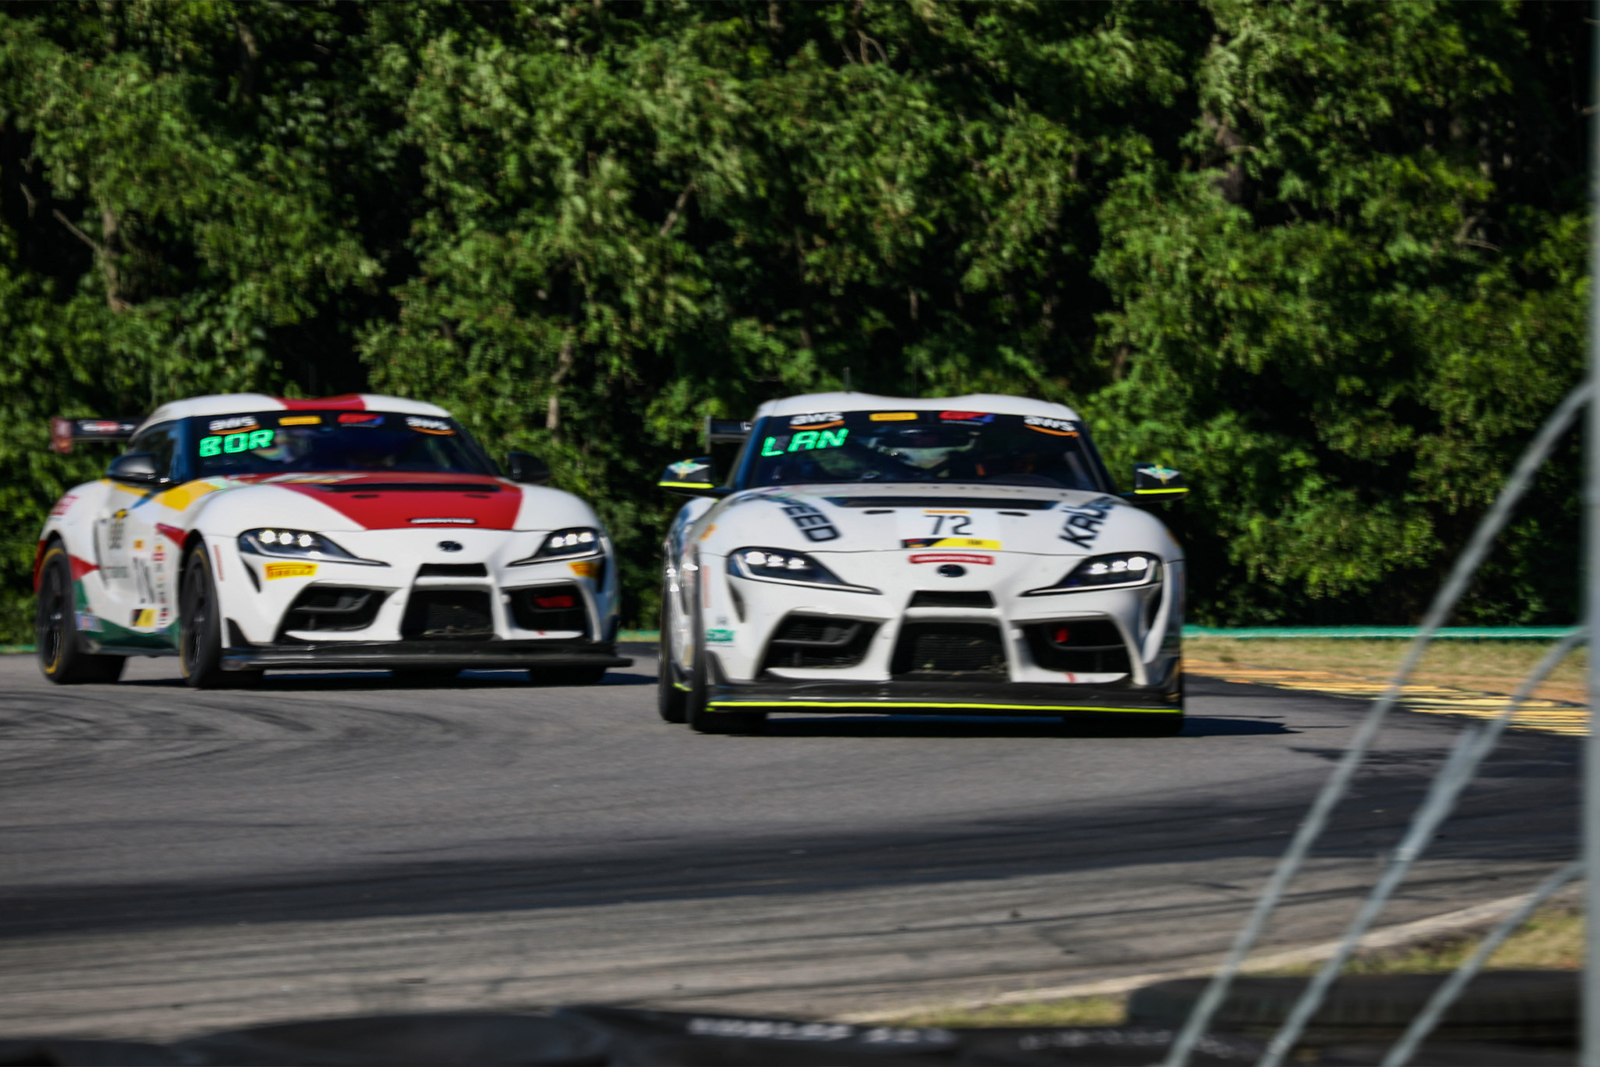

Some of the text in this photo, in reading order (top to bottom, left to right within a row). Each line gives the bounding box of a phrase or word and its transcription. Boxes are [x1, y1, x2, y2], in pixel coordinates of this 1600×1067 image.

[209, 416, 257, 431] aws
[405, 416, 451, 430] aws
[790, 412, 844, 425] aws
[1024, 415, 1076, 431] aws
[199, 429, 275, 458] BOR
[761, 428, 849, 457] LAN
[924, 514, 973, 535] 72
